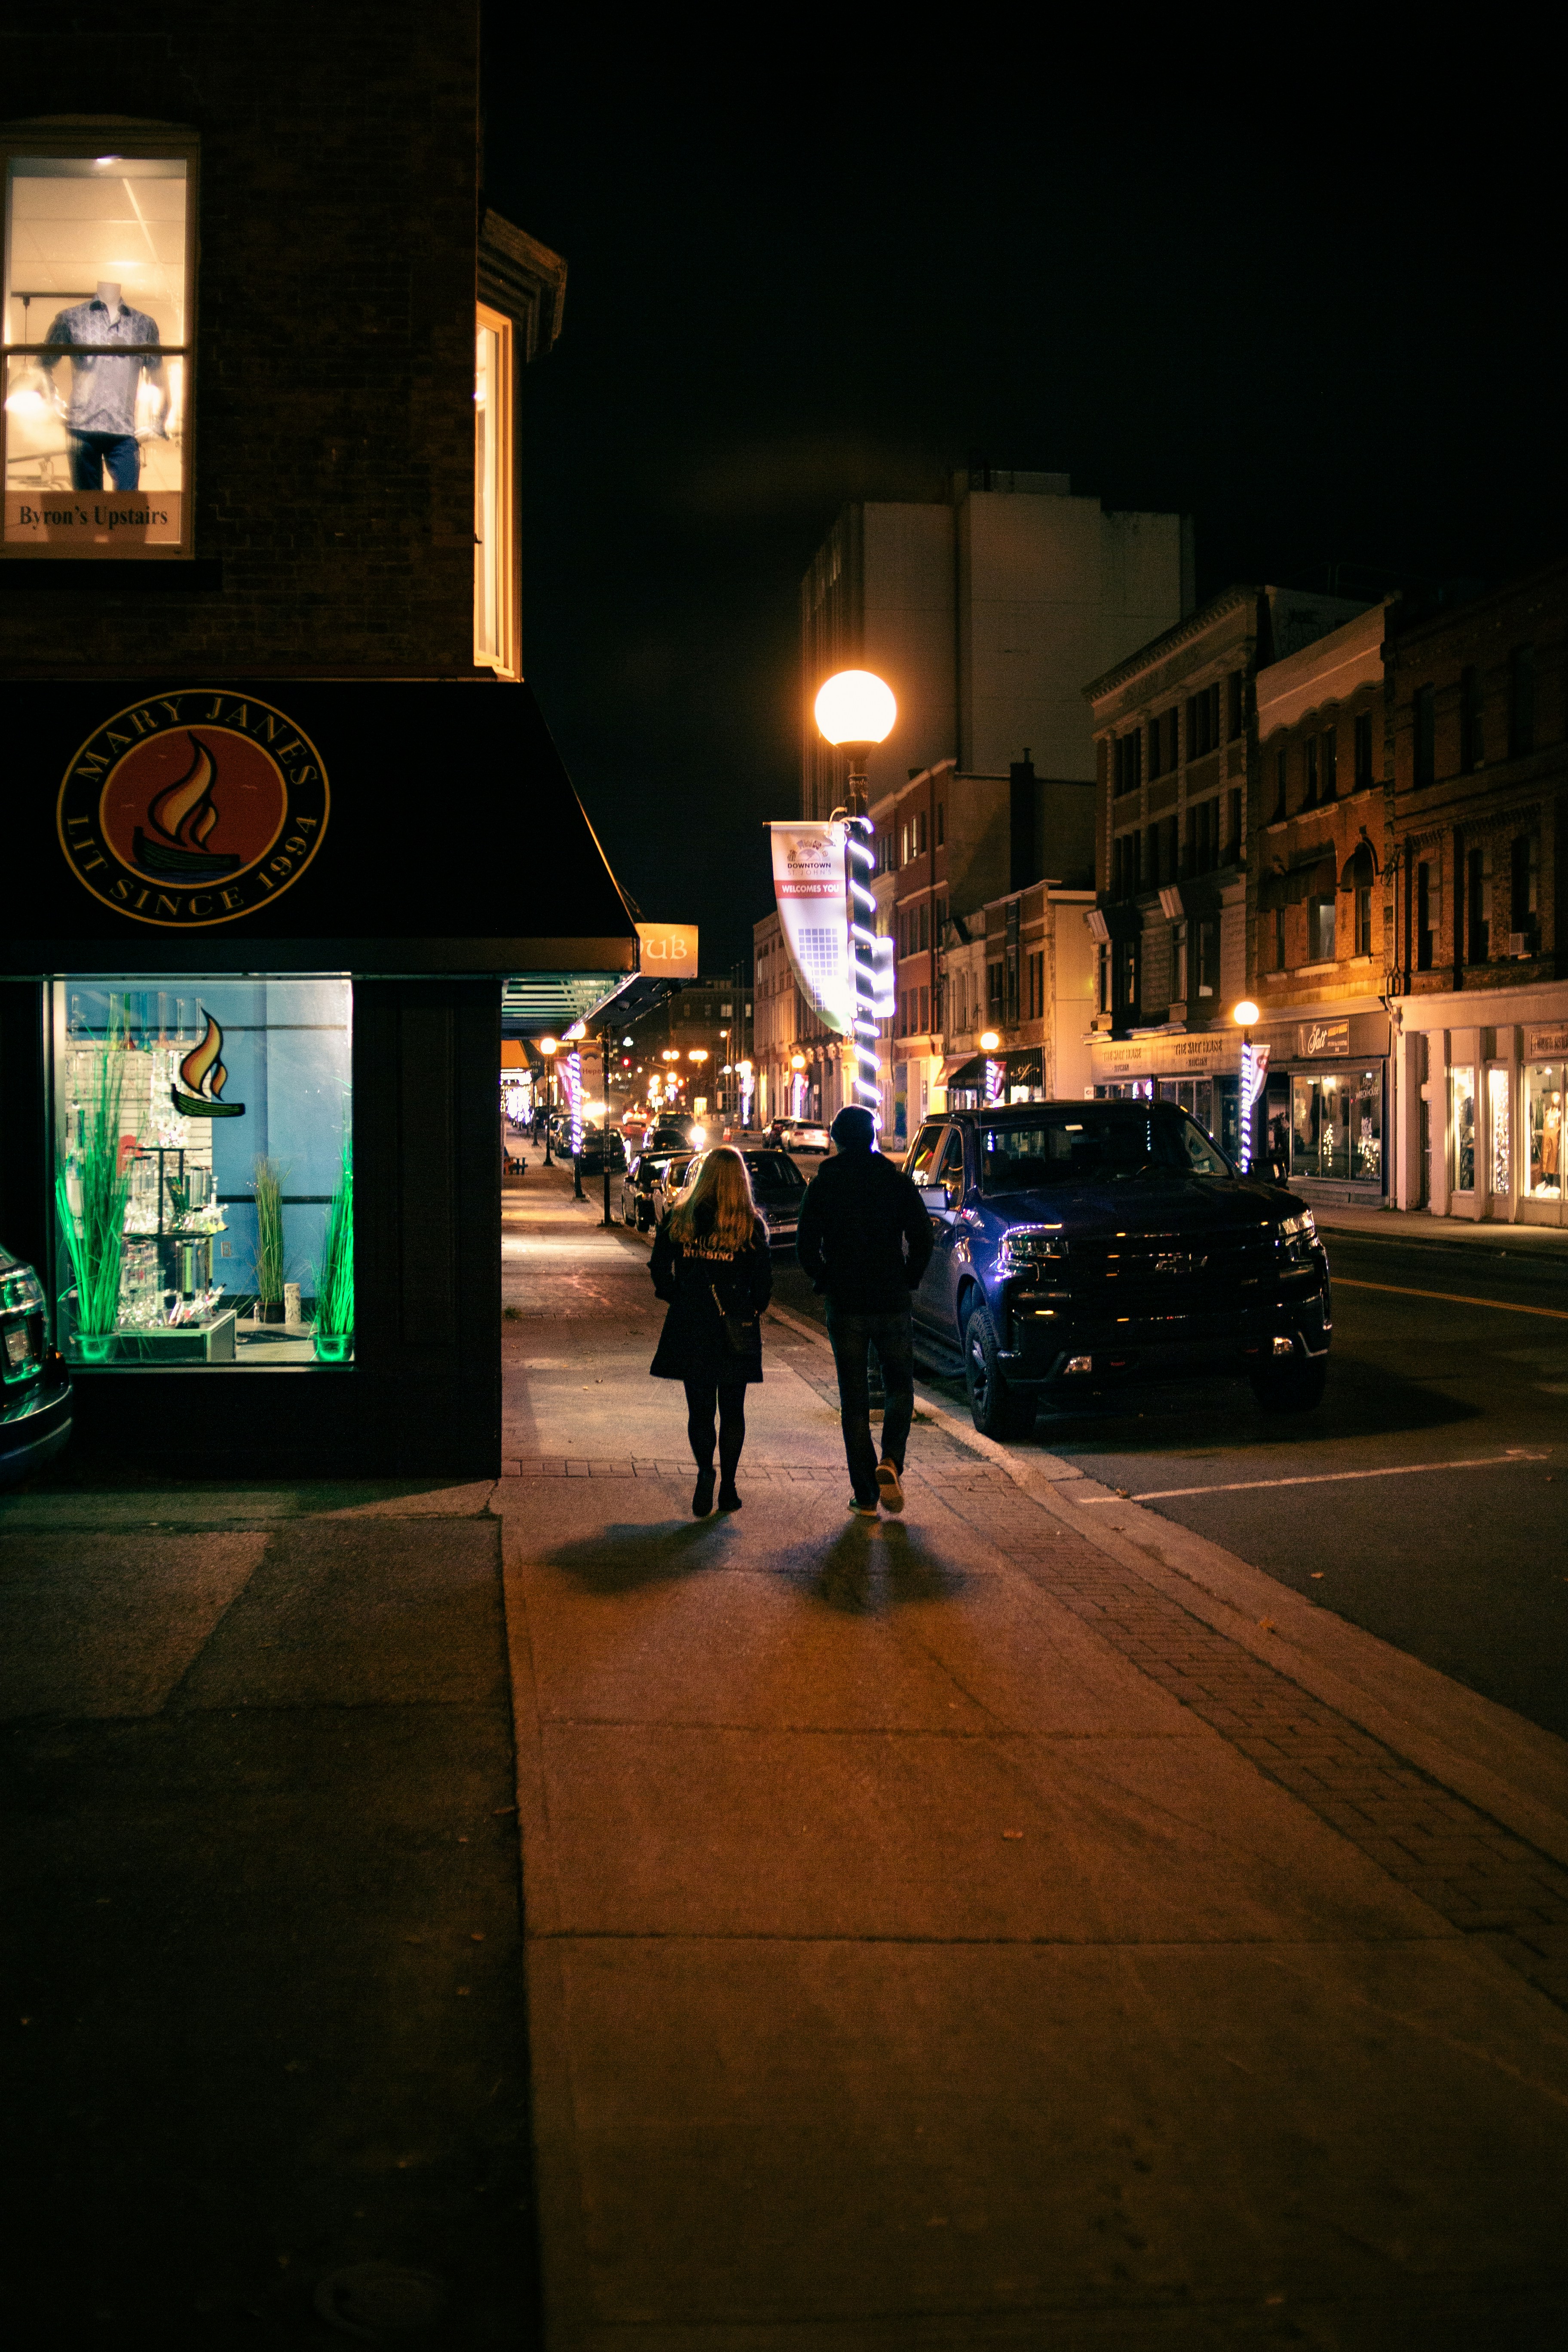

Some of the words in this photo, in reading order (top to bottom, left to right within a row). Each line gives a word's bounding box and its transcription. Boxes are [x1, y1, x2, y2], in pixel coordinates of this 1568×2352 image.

[20, 505, 88, 530] Byron's
[94, 505, 168, 530] Upstairs
[74, 697, 184, 784] MARY
[205, 697, 318, 786] JANES
[67, 814, 110, 873] LIT
[108, 877, 245, 916] SINCE
[255, 815, 318, 891] 1994
[781, 885, 821, 893] WELCOMES
[823, 884, 839, 893] YOU
